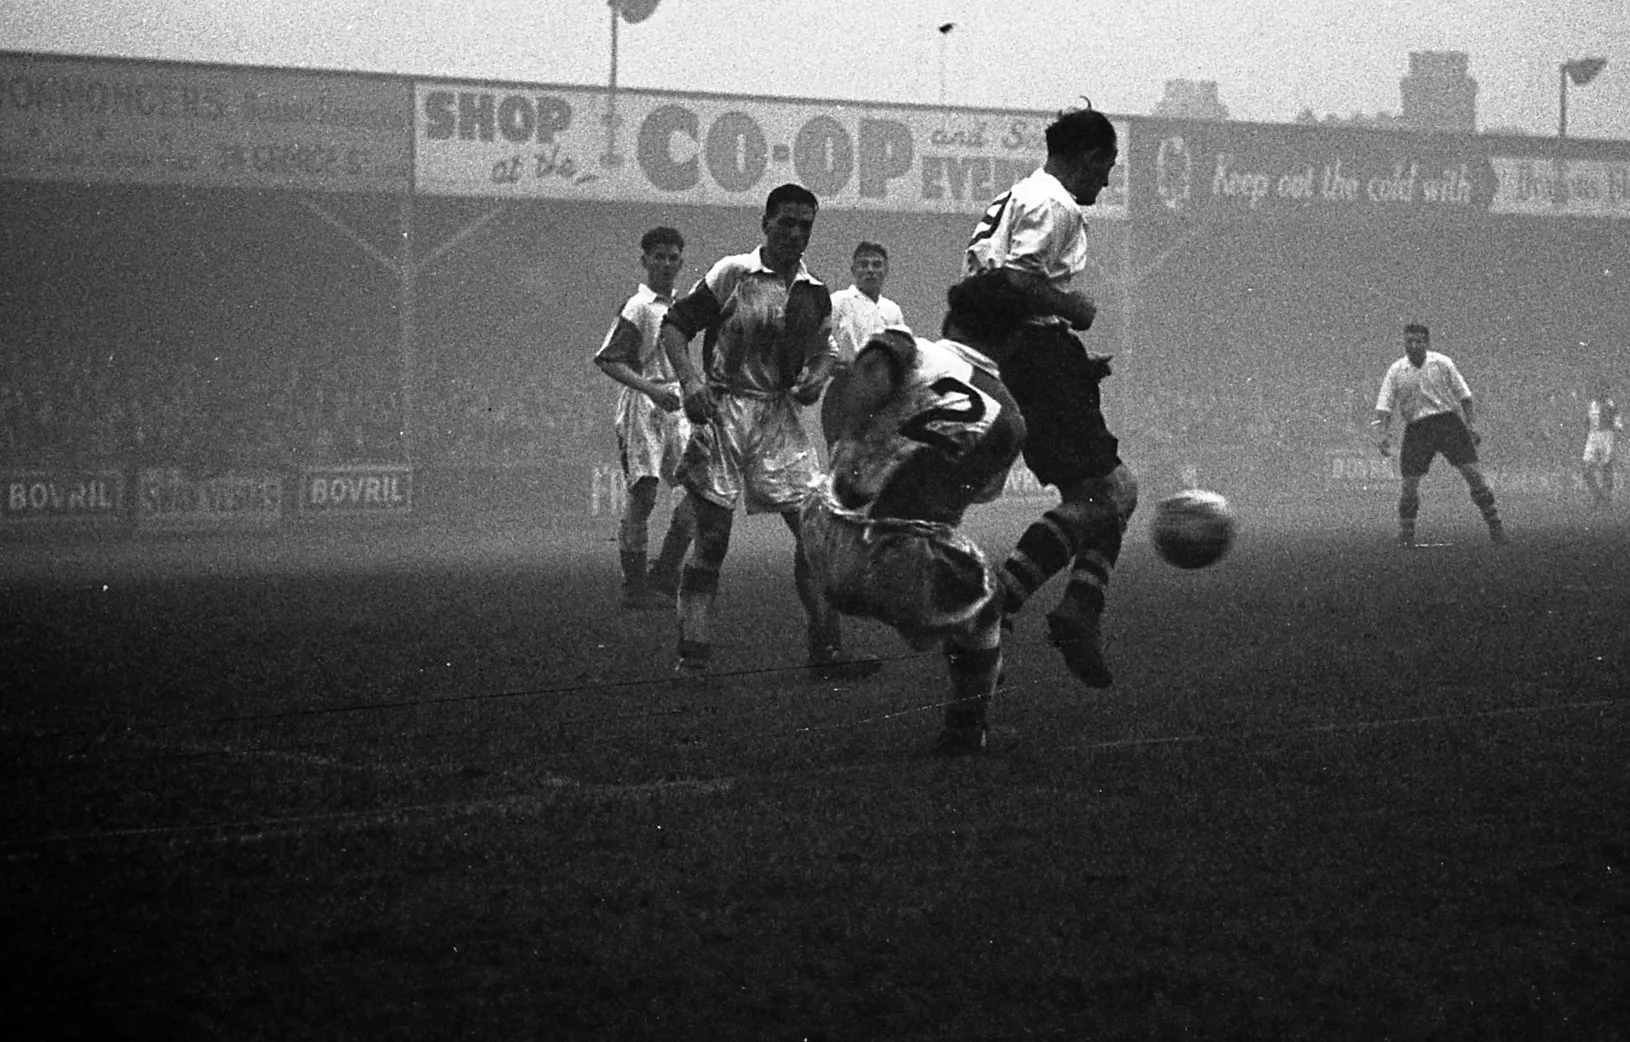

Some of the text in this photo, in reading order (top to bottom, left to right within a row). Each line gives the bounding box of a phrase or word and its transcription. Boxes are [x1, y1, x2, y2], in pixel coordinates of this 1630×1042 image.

[425, 91, 571, 143] SHOP
[931, 119, 984, 147] and
[491, 143, 575, 184] at the
[637, 105, 912, 197] CO-OP
[1213, 153, 1268, 208] Keep
[1278, 166, 1314, 198] out
[1321, 157, 1358, 201] the
[1366, 161, 1419, 202] cold
[1423, 163, 1471, 203] with
[899, 376, 986, 449] 2
[9, 481, 111, 510] BOVRIL
[311, 476, 402, 504] BOVRIL
